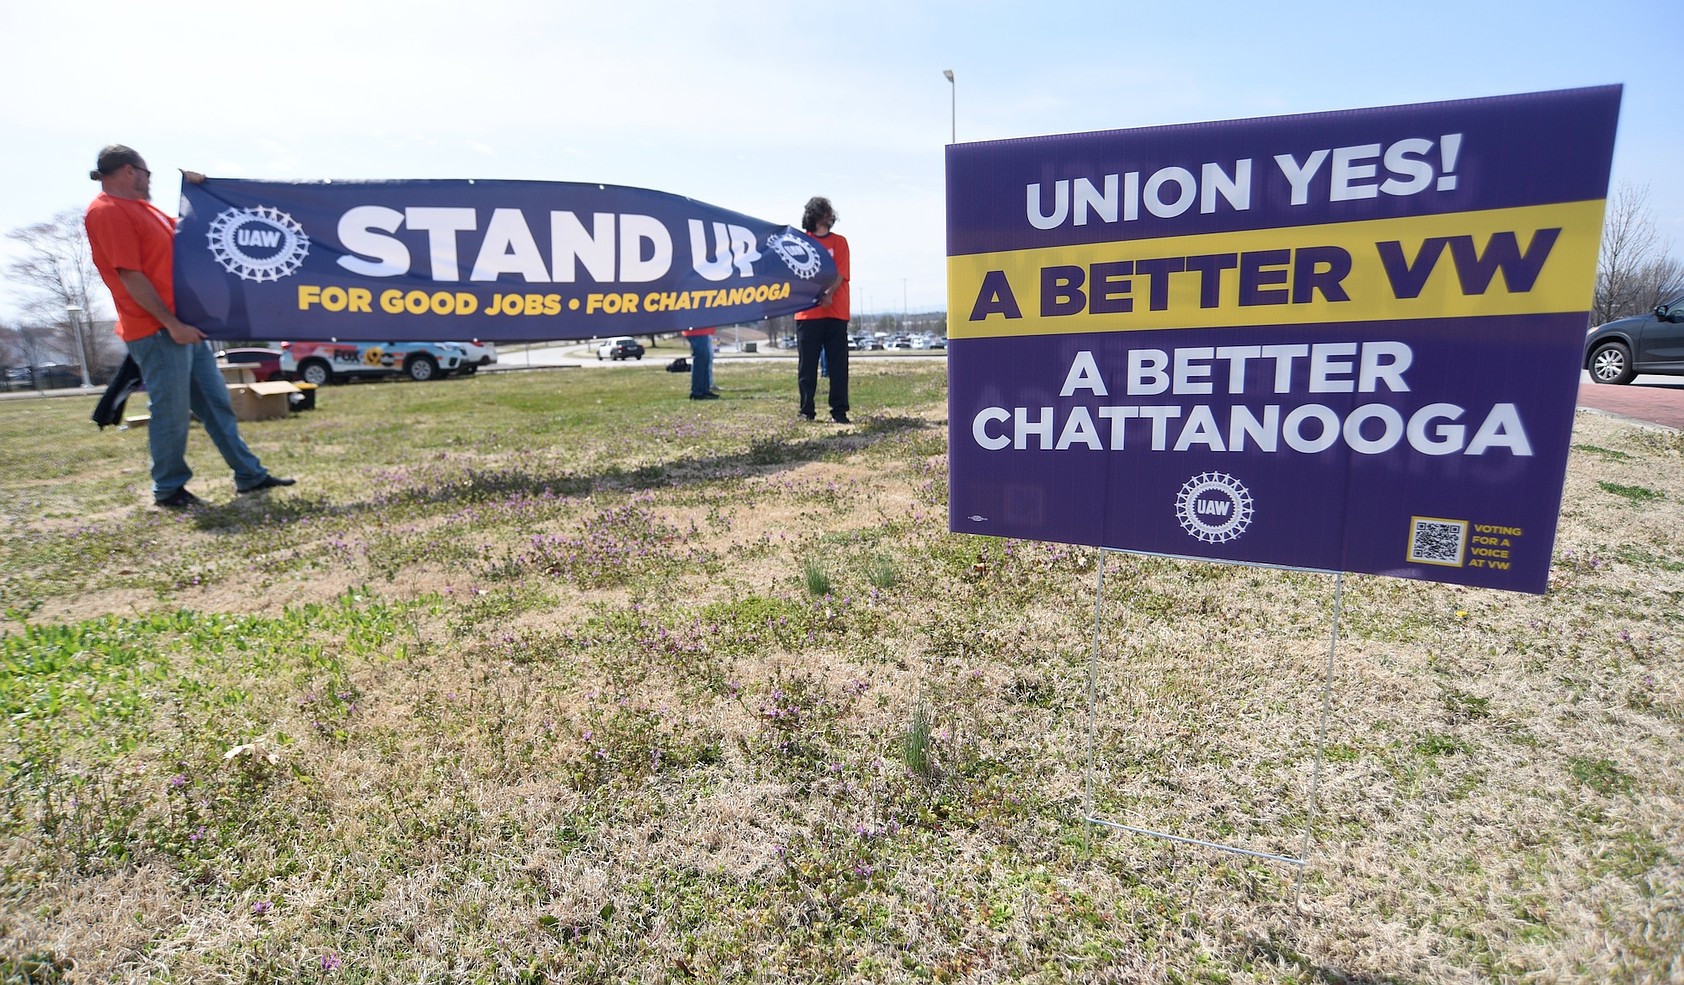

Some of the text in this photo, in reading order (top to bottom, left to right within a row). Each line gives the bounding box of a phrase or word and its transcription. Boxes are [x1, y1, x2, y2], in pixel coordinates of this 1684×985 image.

[1026, 133, 1463, 230] UNION YES!
[237, 229, 281, 248] UAW
[336, 205, 674, 283] STAND
[687, 218, 762, 282] UP
[969, 226, 1563, 322] A BETTER VW
[297, 282, 791, 316] FOR GOOD JOBS FOR CHATTANOOGA
[334, 349, 361, 363] FOX
[1060, 341, 1413, 397] A BETTER
[972, 402, 1533, 457] CHATTANOOGA
[1197, 499, 1231, 516] UAW
[1474, 525, 1521, 536] VOTING
[1472, 536, 1498, 545] FOR
[1471, 547, 1508, 558] VOICE
[1469, 559, 1510, 570] AT VW
